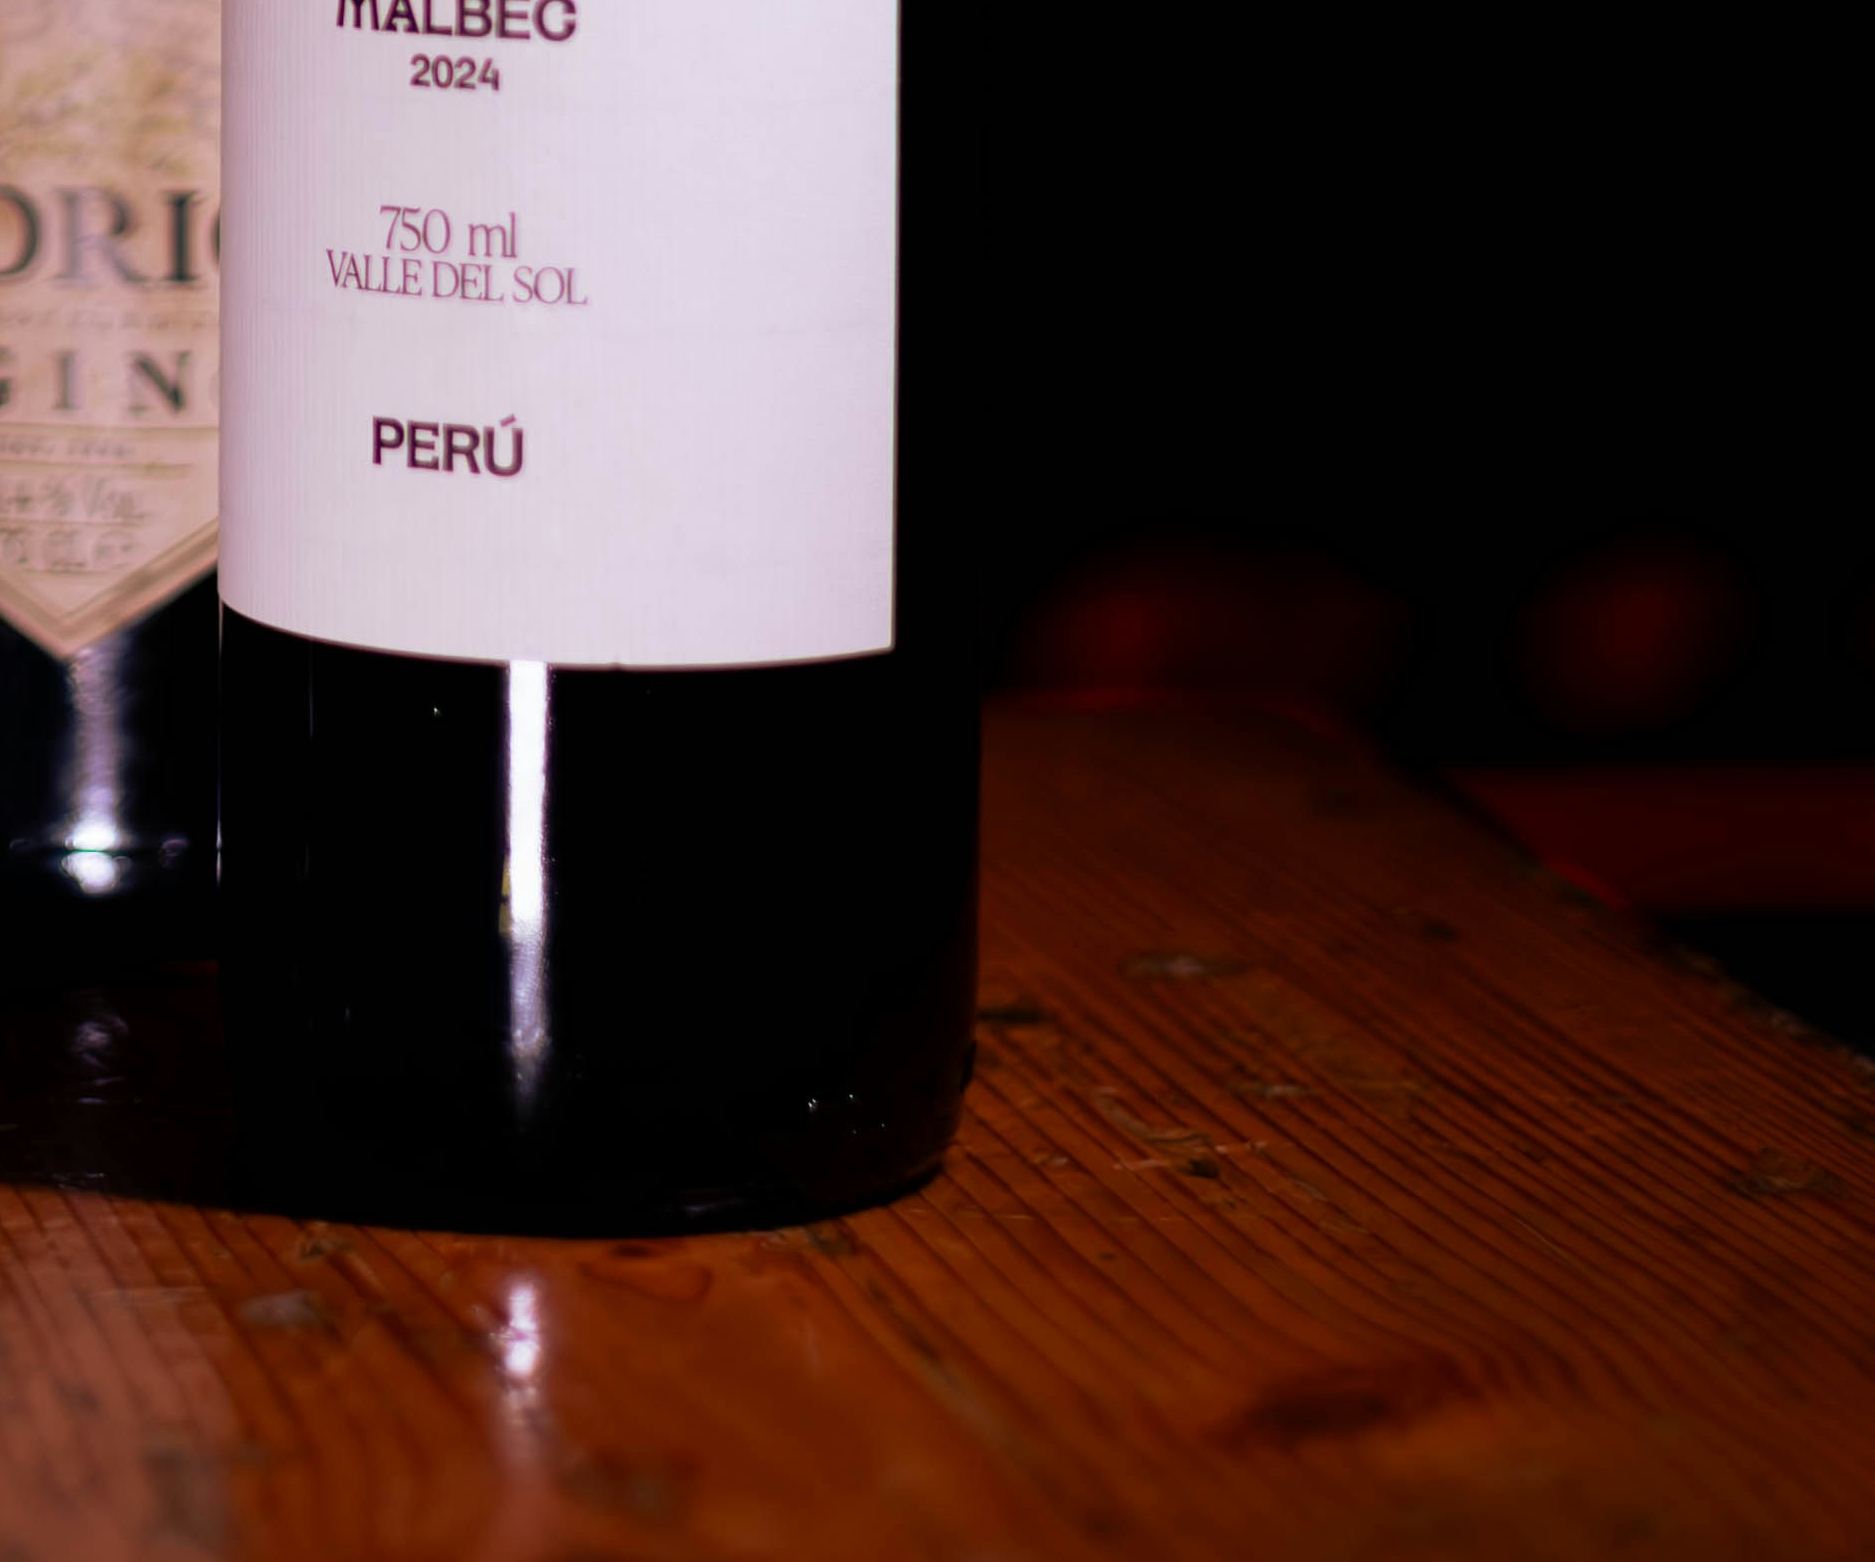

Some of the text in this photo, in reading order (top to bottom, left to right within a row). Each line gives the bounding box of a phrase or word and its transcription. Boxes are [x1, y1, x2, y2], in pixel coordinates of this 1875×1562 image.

[409, 54, 501, 91] 2024
[379, 205, 518, 259] 750 ml
[326, 249, 588, 306] VALLE DEL SOL
[372, 414, 524, 478] PERÚ
